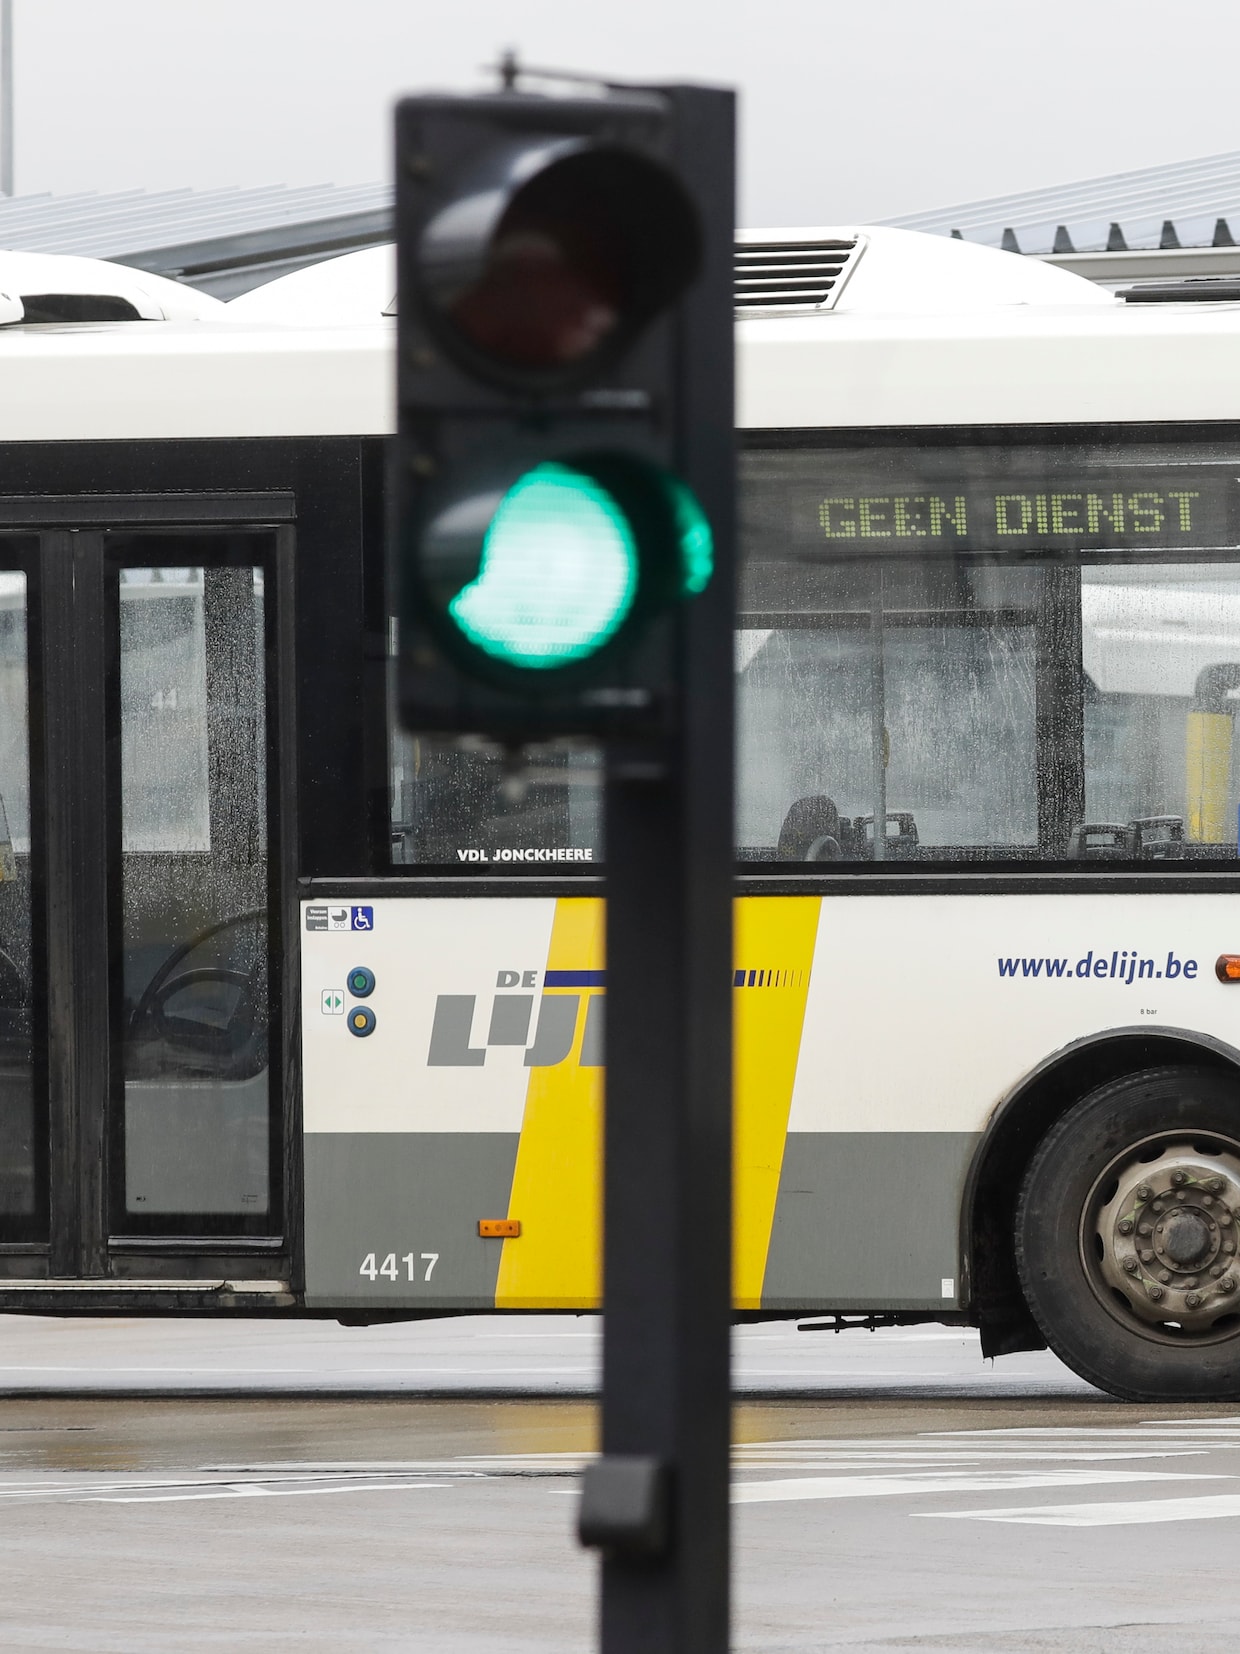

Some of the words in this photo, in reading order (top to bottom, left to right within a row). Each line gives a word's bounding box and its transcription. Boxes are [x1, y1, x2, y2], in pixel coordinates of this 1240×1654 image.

[819, 495, 968, 538] GEEN
[995, 491, 1200, 535] DIENST
[457, 849, 488, 861] VDL
[493, 848, 593, 861] JONCKHEERE
[496, 971, 537, 987] DE
[998, 951, 1198, 985] www.delijn.be
[359, 1253, 439, 1281] 4417
